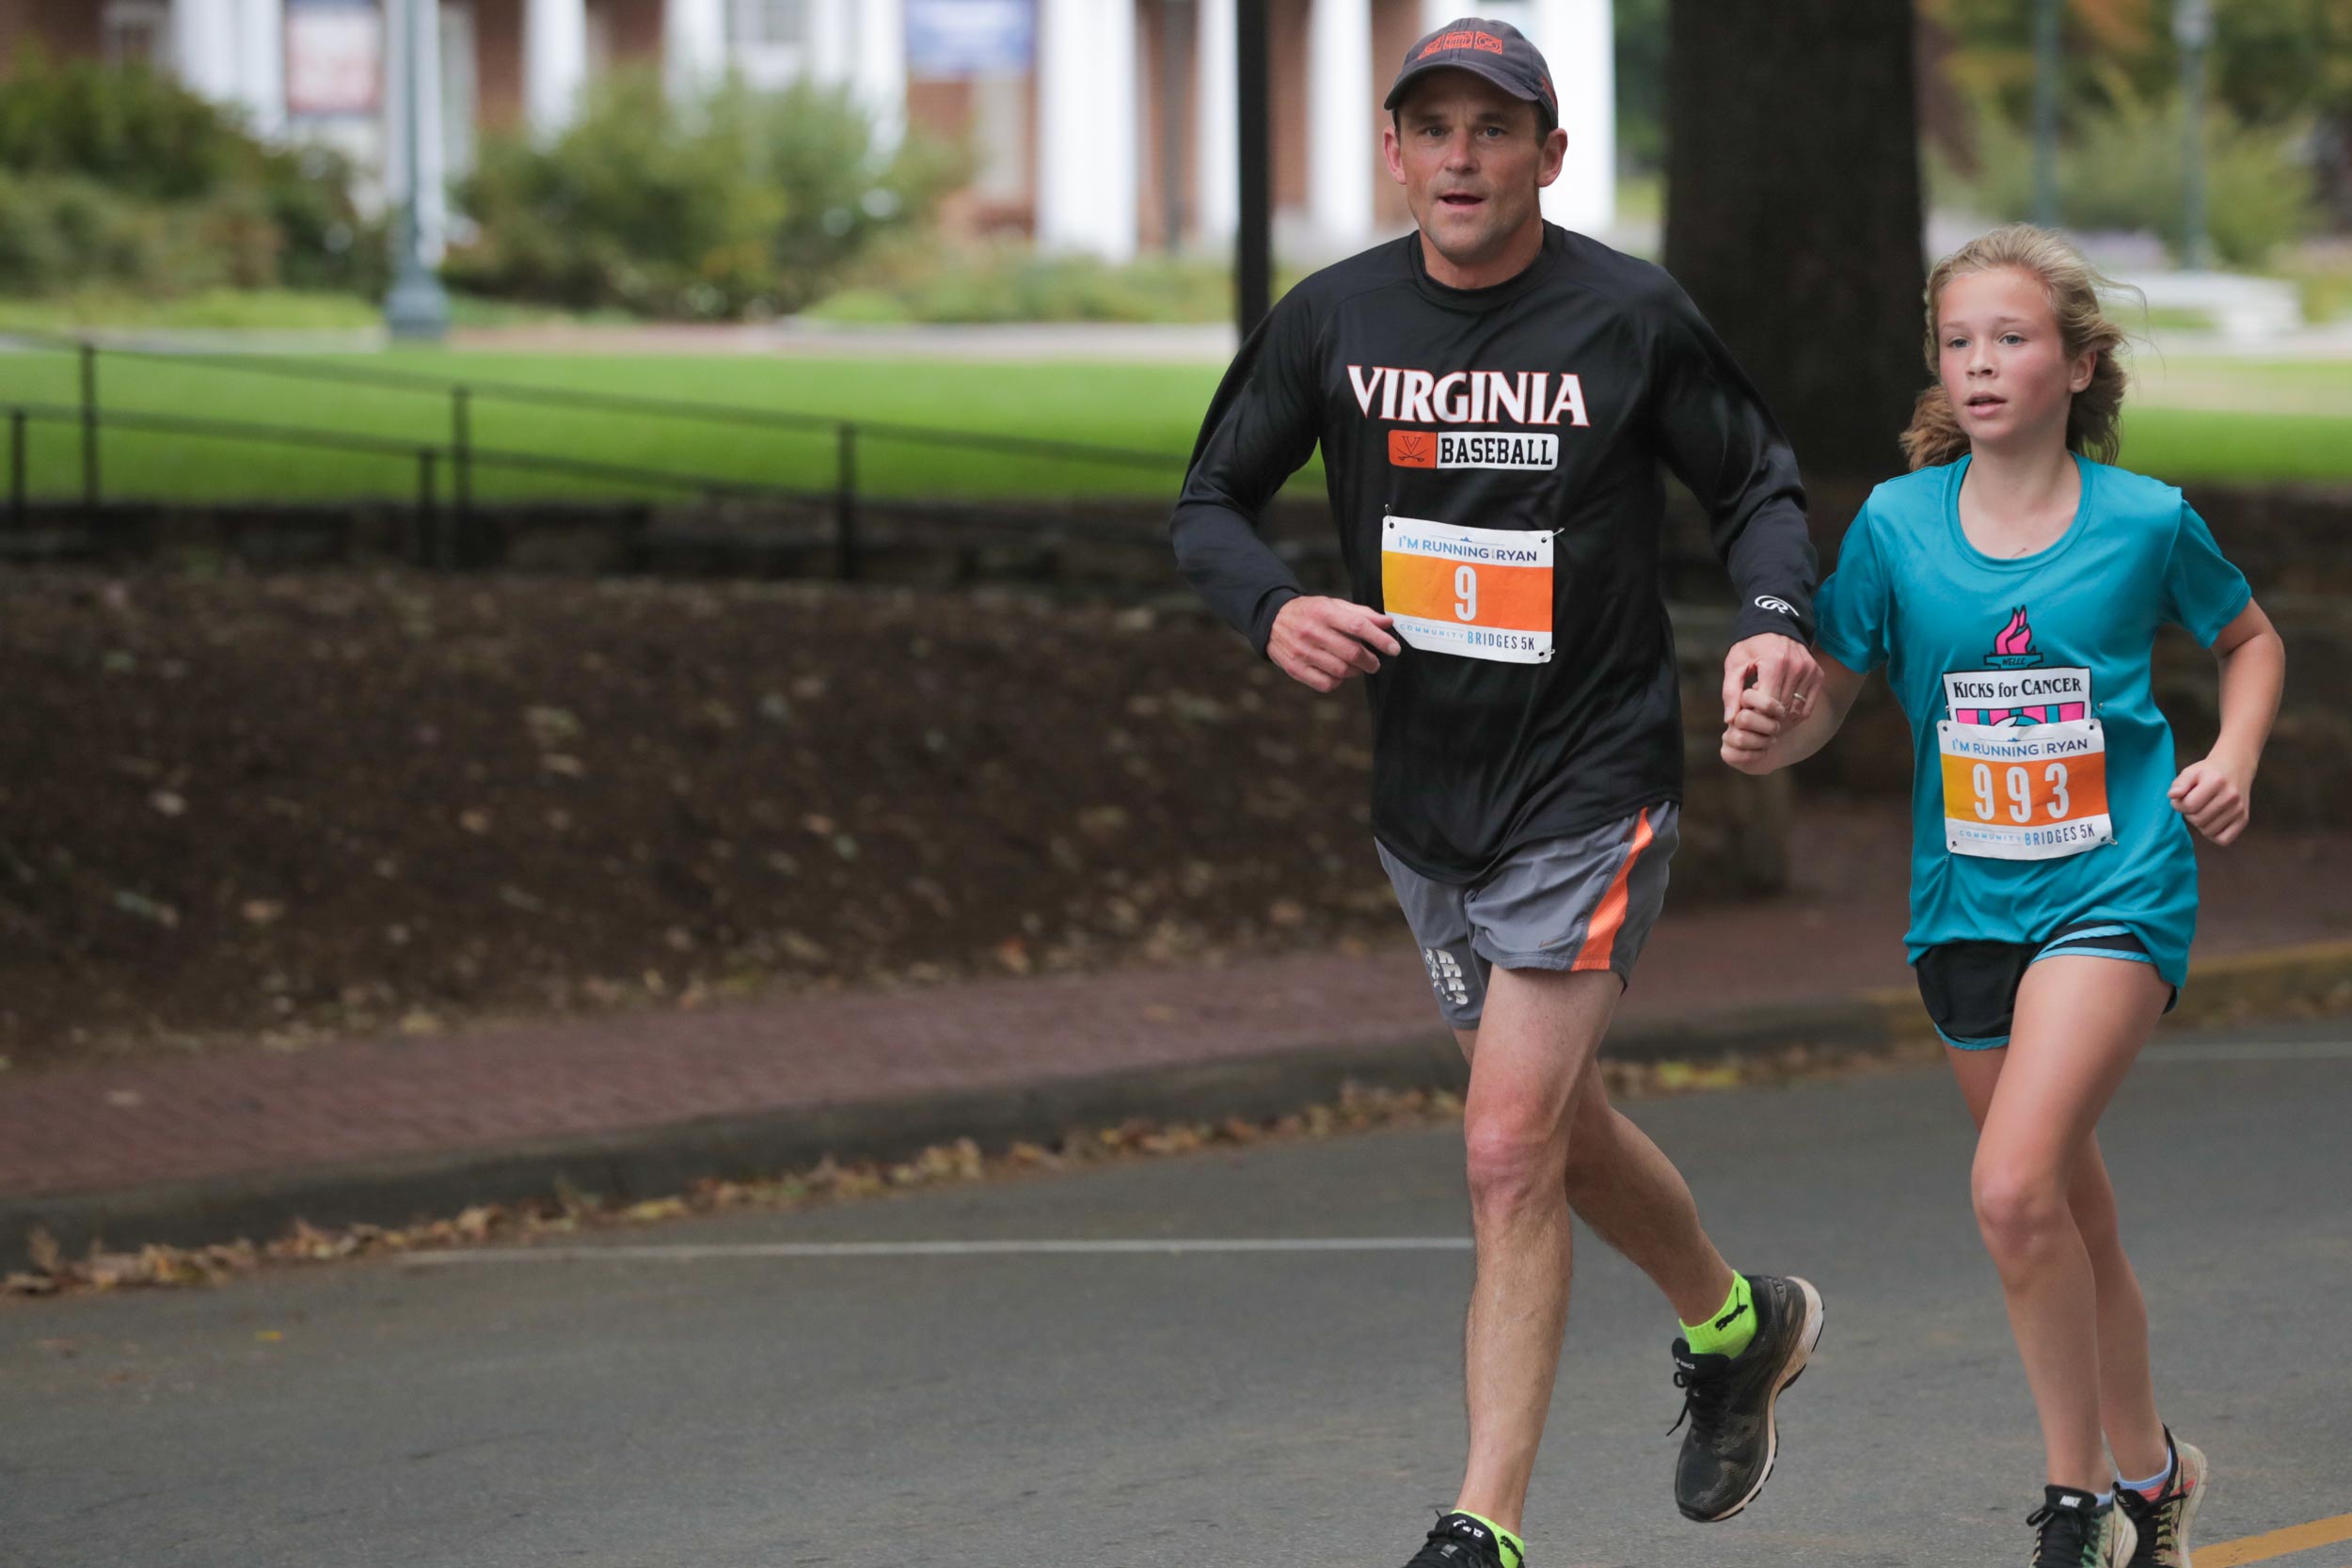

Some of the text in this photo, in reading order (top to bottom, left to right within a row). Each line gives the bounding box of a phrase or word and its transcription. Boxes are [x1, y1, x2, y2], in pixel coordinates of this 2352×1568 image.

[1347, 365, 1590, 427] VIRGINIA
[1440, 437, 1552, 466] BASEBALL
[1399, 535, 1418, 549] I'M
[1422, 540, 1489, 559] RUNNING
[1496, 549, 1537, 562] RYAN
[1454, 565, 1477, 622] 9
[1400, 624, 1535, 651] COMMUNITY BRIDGES 5K
[1953, 678, 2082, 698] KICKS for CANCER
[1952, 737, 1970, 752] I'M
[1975, 742, 2039, 757] RUNNING
[2047, 738, 2088, 753] RYAN
[1972, 763, 2070, 823] 993
[1959, 823, 2095, 846] COMMUNITY BRIDGES 5K
